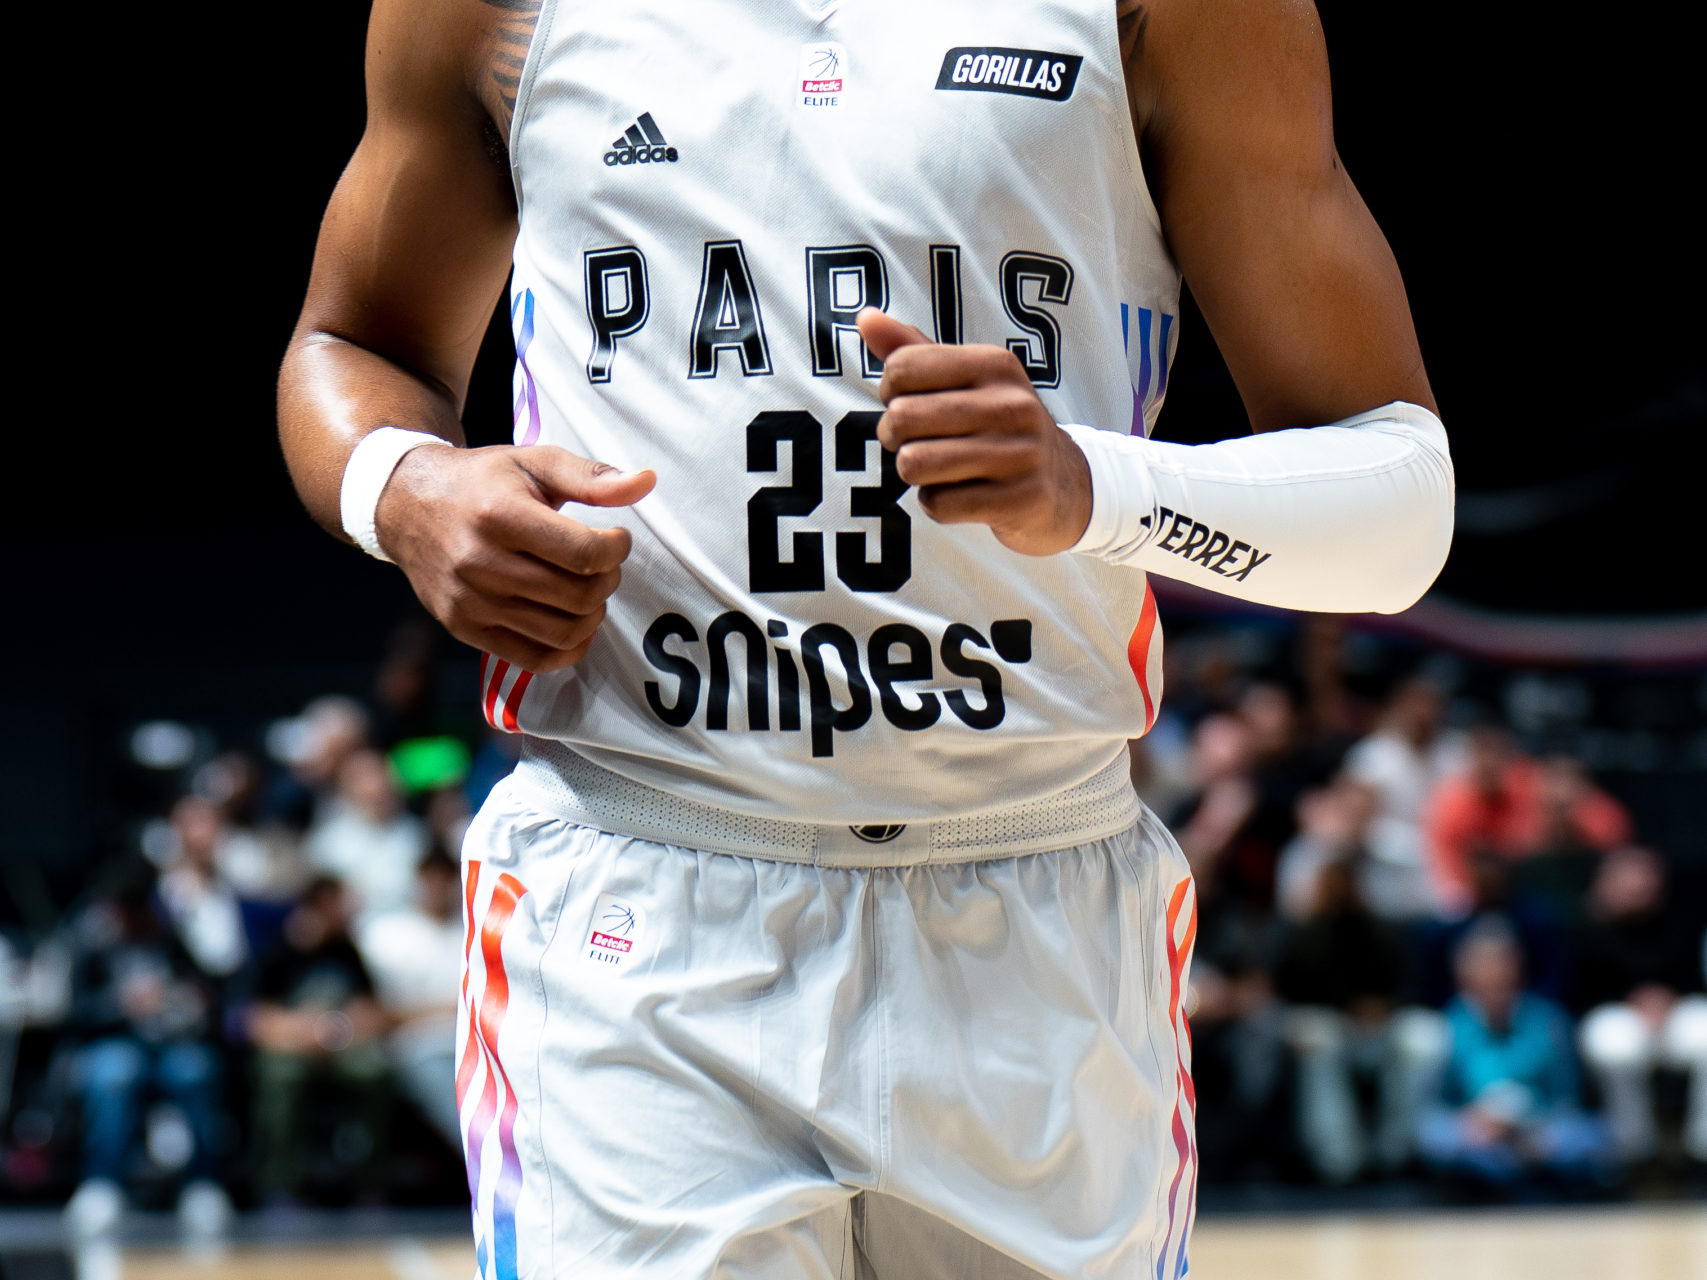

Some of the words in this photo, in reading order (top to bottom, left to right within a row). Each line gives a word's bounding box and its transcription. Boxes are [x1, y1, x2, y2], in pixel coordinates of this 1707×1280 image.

[952, 53, 1066, 92] GORILLAS
[603, 144, 679, 166] adidas
[583, 240, 1074, 389] PARIS
[746, 410, 912, 594] 23
[643, 610, 1006, 758] snipes
